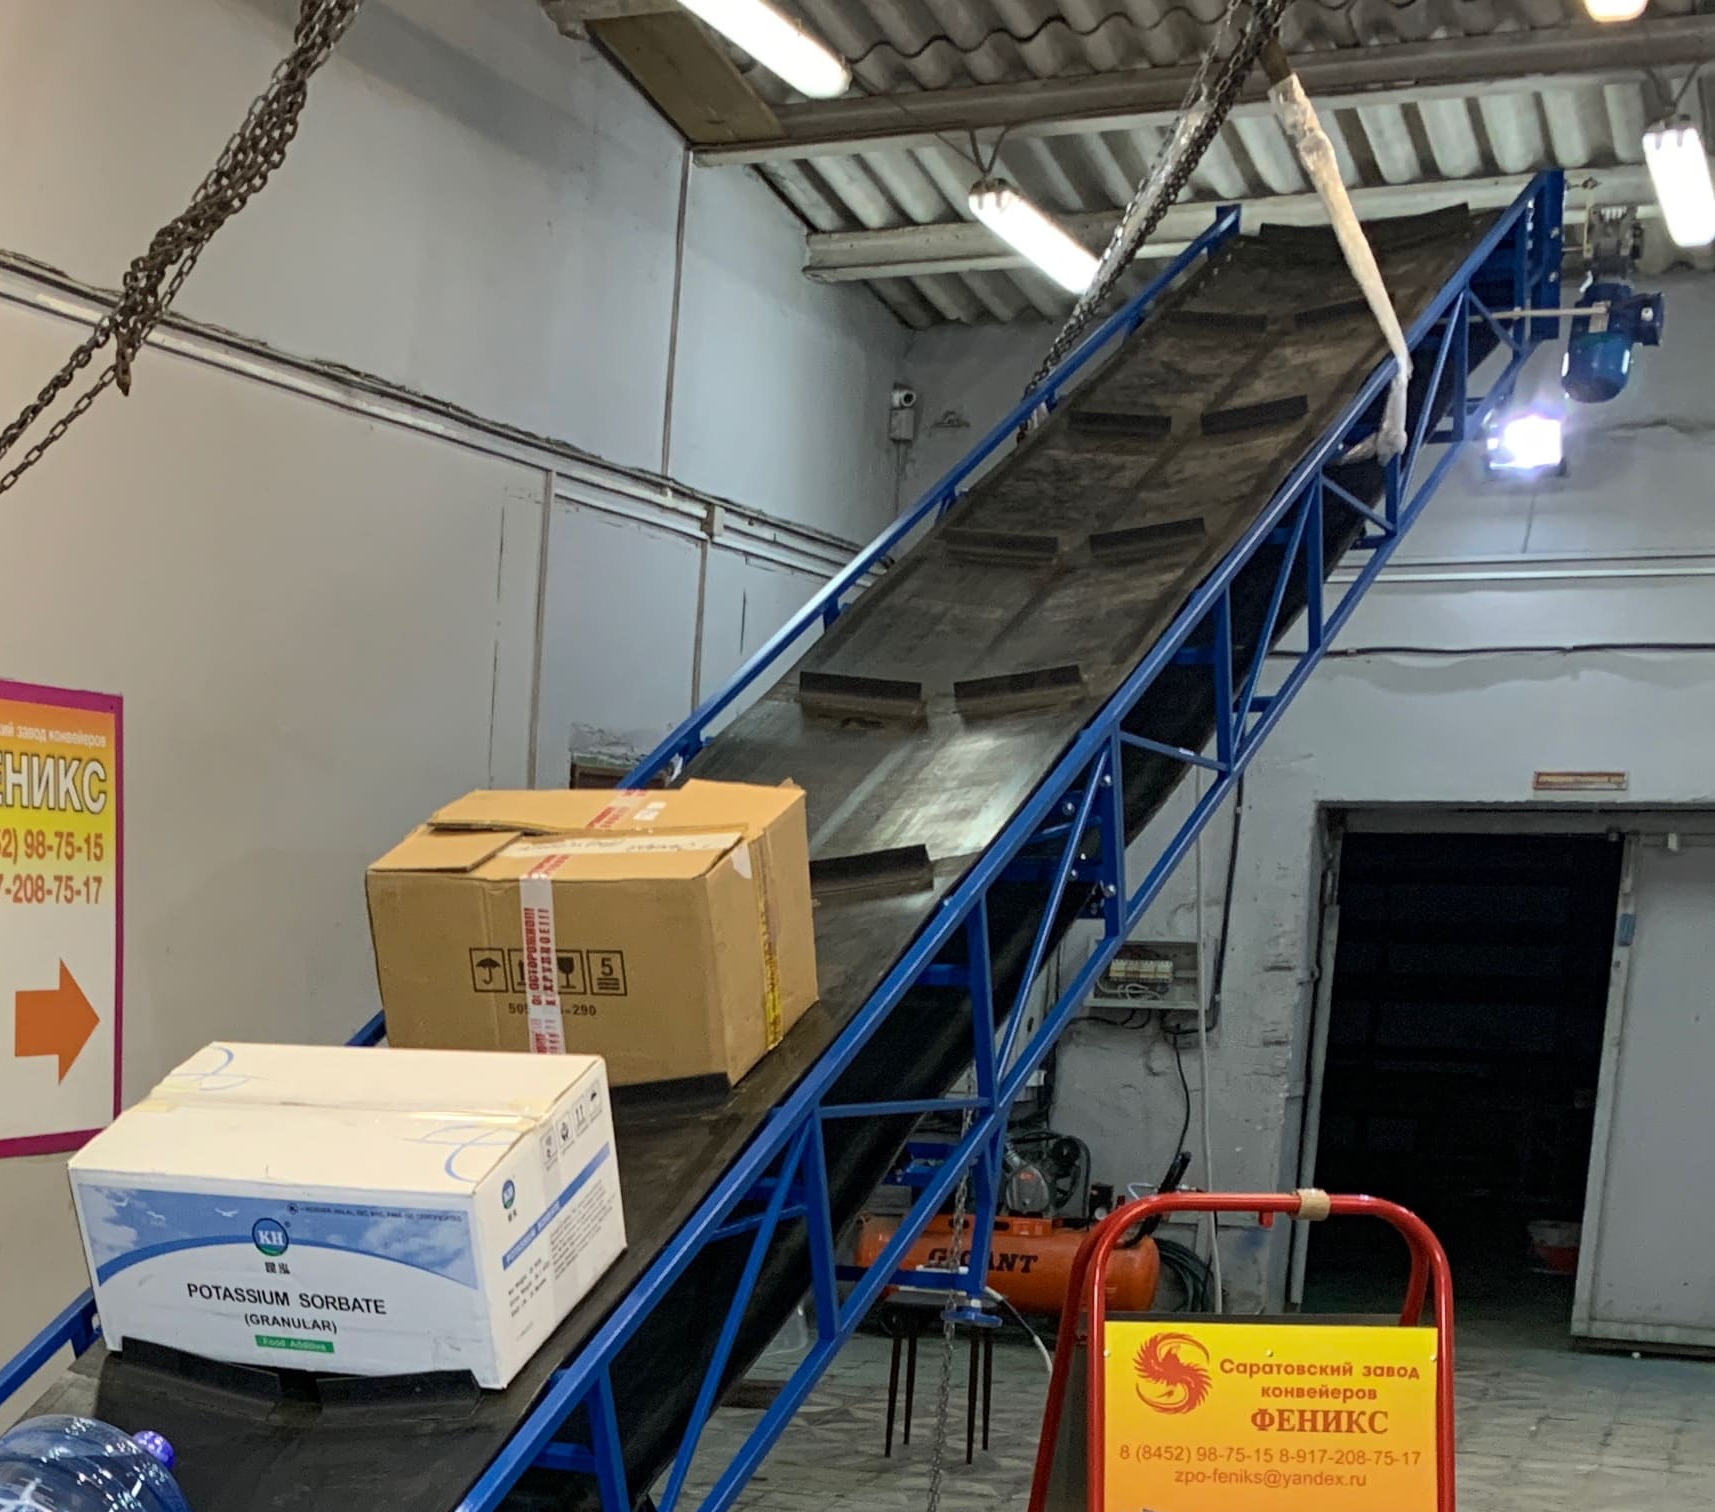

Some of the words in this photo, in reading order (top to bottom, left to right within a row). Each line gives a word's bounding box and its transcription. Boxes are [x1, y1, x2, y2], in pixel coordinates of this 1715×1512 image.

[17, 725, 46, 743] завод
[49, 730, 106, 748] конвейеров
[25, 830, 104, 861] 98-75-15
[601, 957, 614, 977] 5
[257, 1230, 284, 1245] KH
[928, 1247, 1039, 1273] GANT
[187, 1283, 290, 1307] POTASSIUM
[298, 1292, 387, 1315] SORBATE
[244, 1313, 337, 1335] (GRANULAR)
[1219, 1358, 1354, 1379] Саратовский
[1361, 1361, 1421, 1381] завод
[1260, 1383, 1378, 1404] конвейеров
[1250, 1407, 1390, 1434] ФЕНИКС
[1119, 1445, 1130, 1461] 8
[1135, 1445, 1192, 1464] (8452)
[1196, 1447, 1274, 1464] 98-75-15
[1279, 1448, 1422, 1466] 8-917-208-75-17
[1174, 1468, 1367, 1489] zpo-feniks@yandex.ru
